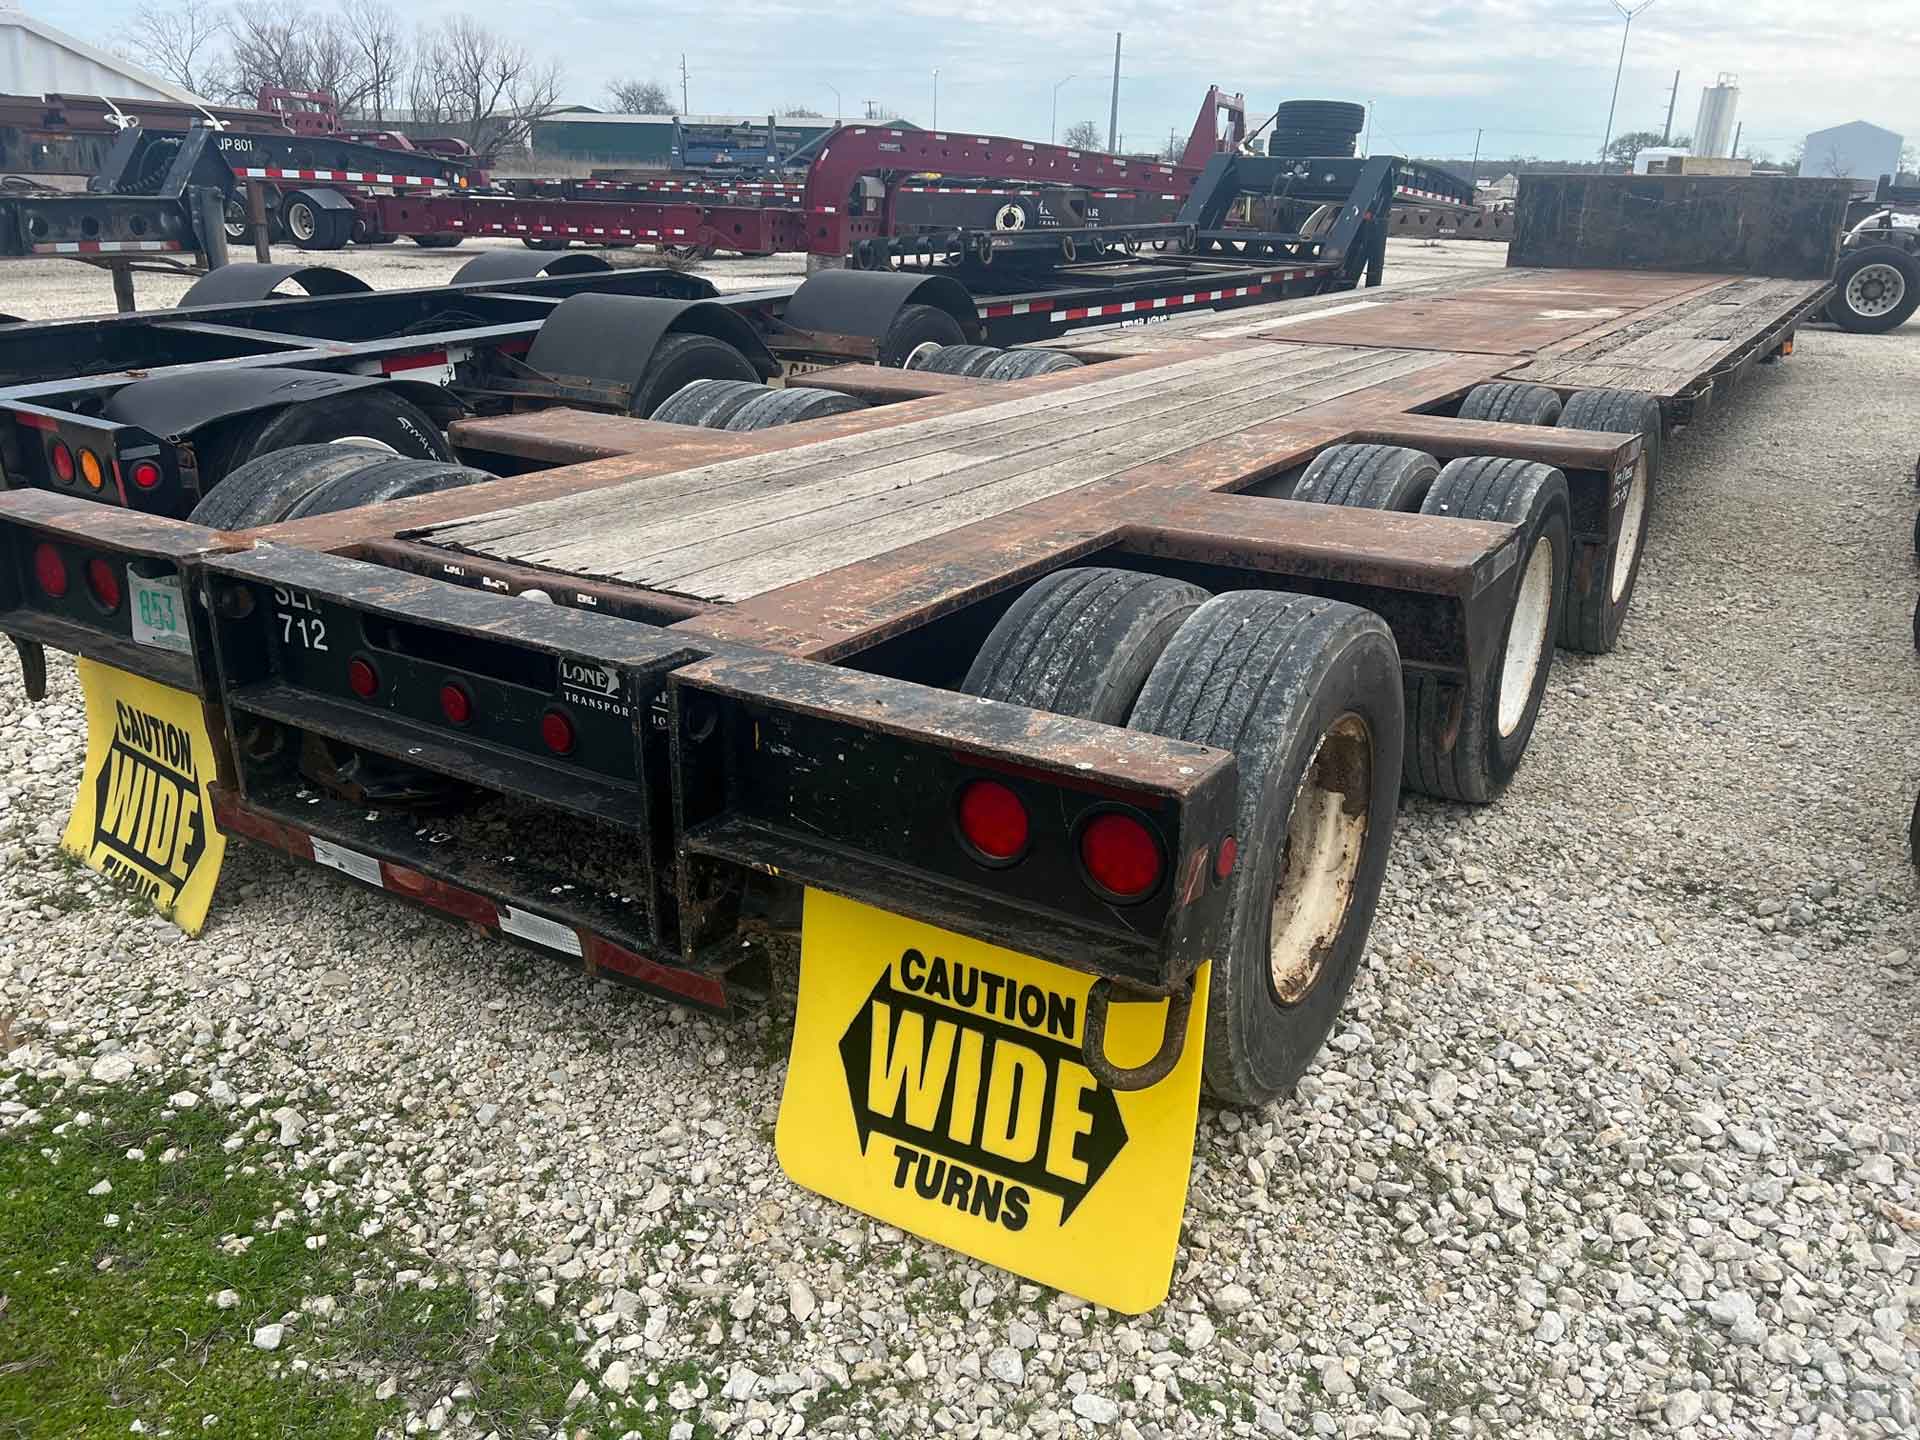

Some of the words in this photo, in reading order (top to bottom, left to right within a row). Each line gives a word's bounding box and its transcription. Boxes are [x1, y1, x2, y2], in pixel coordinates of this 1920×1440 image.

[234, 139, 253, 152] 801
[278, 612, 329, 651] 712
[562, 663, 608, 688] LONE
[115, 699, 194, 775] CAUTION
[100, 747, 200, 883] WIDE
[900, 947, 1077, 1040] CAUTION
[867, 999, 1099, 1186] WIDE
[892, 1144, 1031, 1232] TURNS
